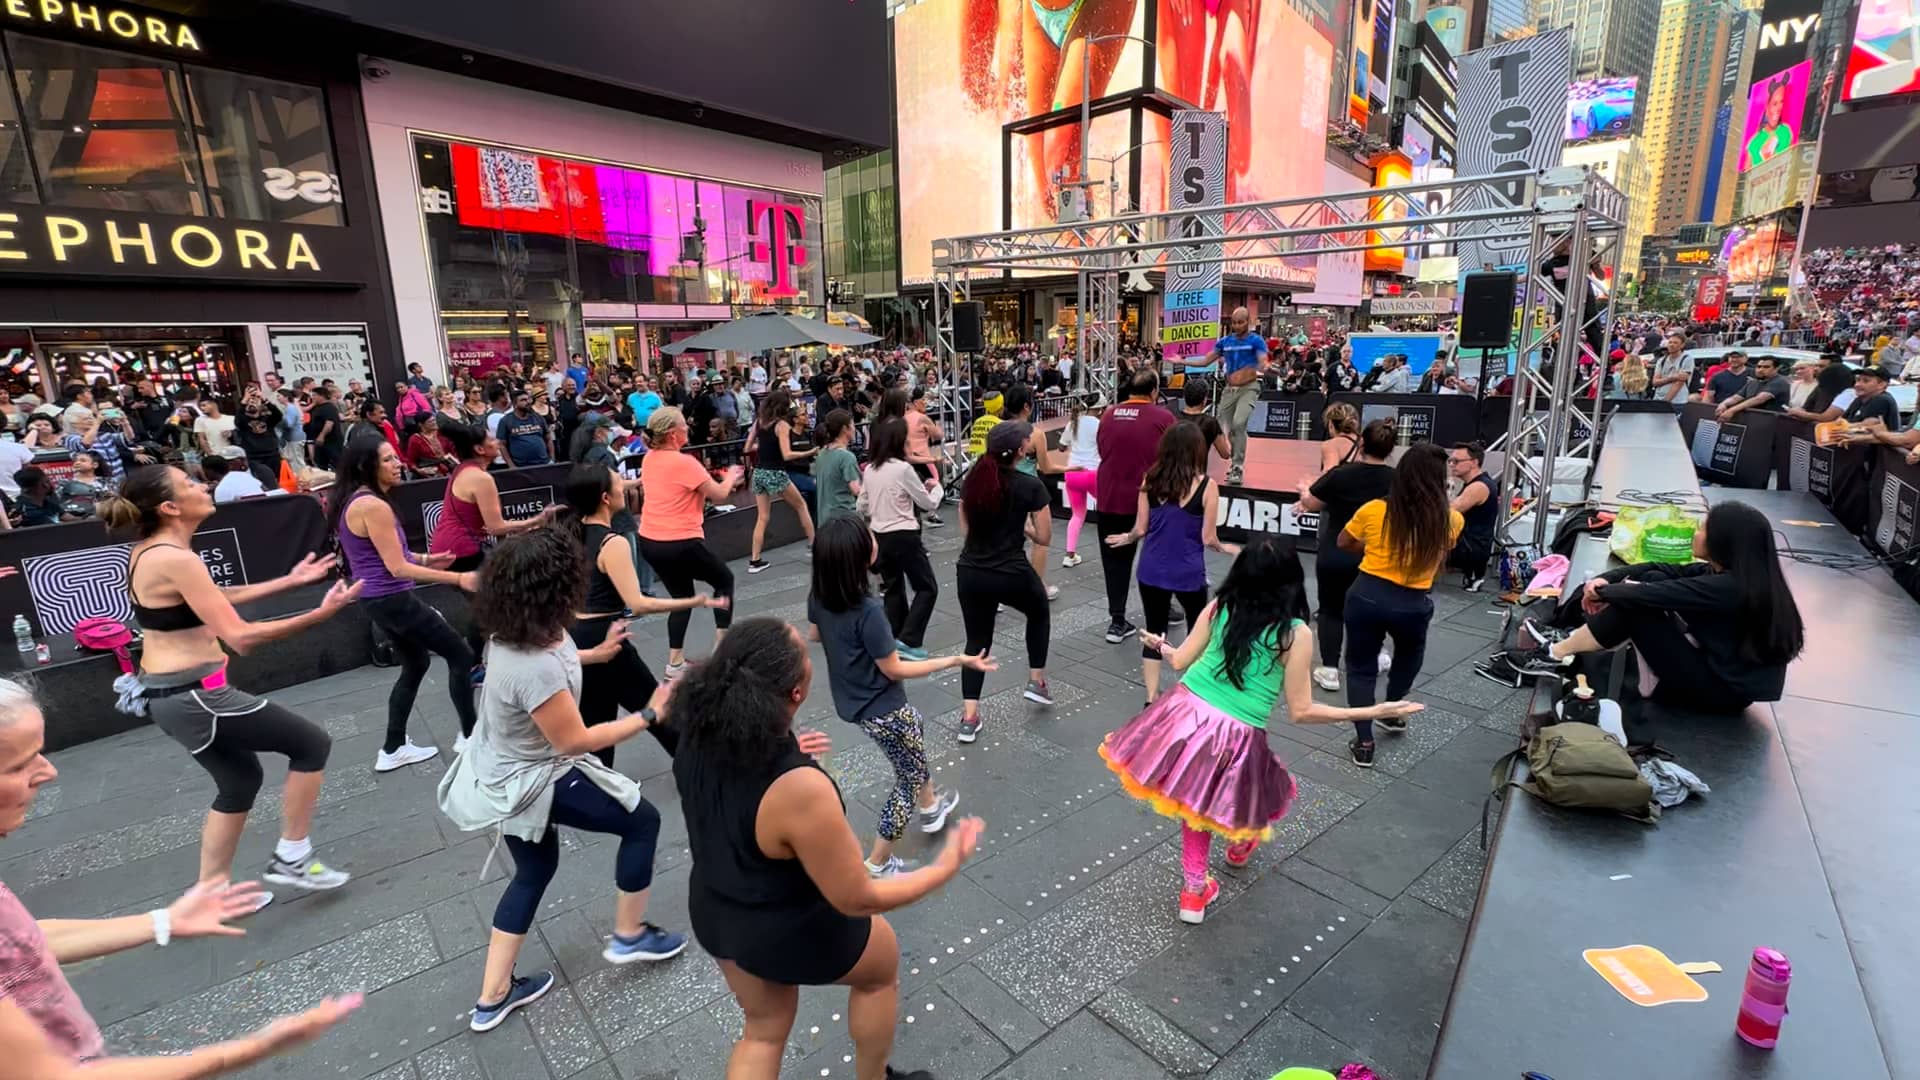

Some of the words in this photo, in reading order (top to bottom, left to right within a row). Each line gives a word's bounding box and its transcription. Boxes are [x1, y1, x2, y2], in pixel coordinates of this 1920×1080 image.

[0, 214, 321, 271] EPHORA
[747, 200, 807, 297] T
[1176, 291, 1204, 306] FREE
[1703, 278, 1723, 305] tkts
[1372, 301, 1436, 311] SWAROVSKI
[1172, 308, 1209, 323] MUSIC
[1171, 325, 1209, 341] DANCE
[291, 343, 308, 351] THE
[311, 342, 349, 351] BIGGEST
[1177, 342, 1200, 355] ART
[291, 351, 353, 362] SEPHORA
[460, 351, 495, 359] EXISTING
[294, 363, 306, 372] IN
[309, 362, 329, 372] THE
[330, 361, 354, 371] USA
[504, 500, 544, 516] TIMES
